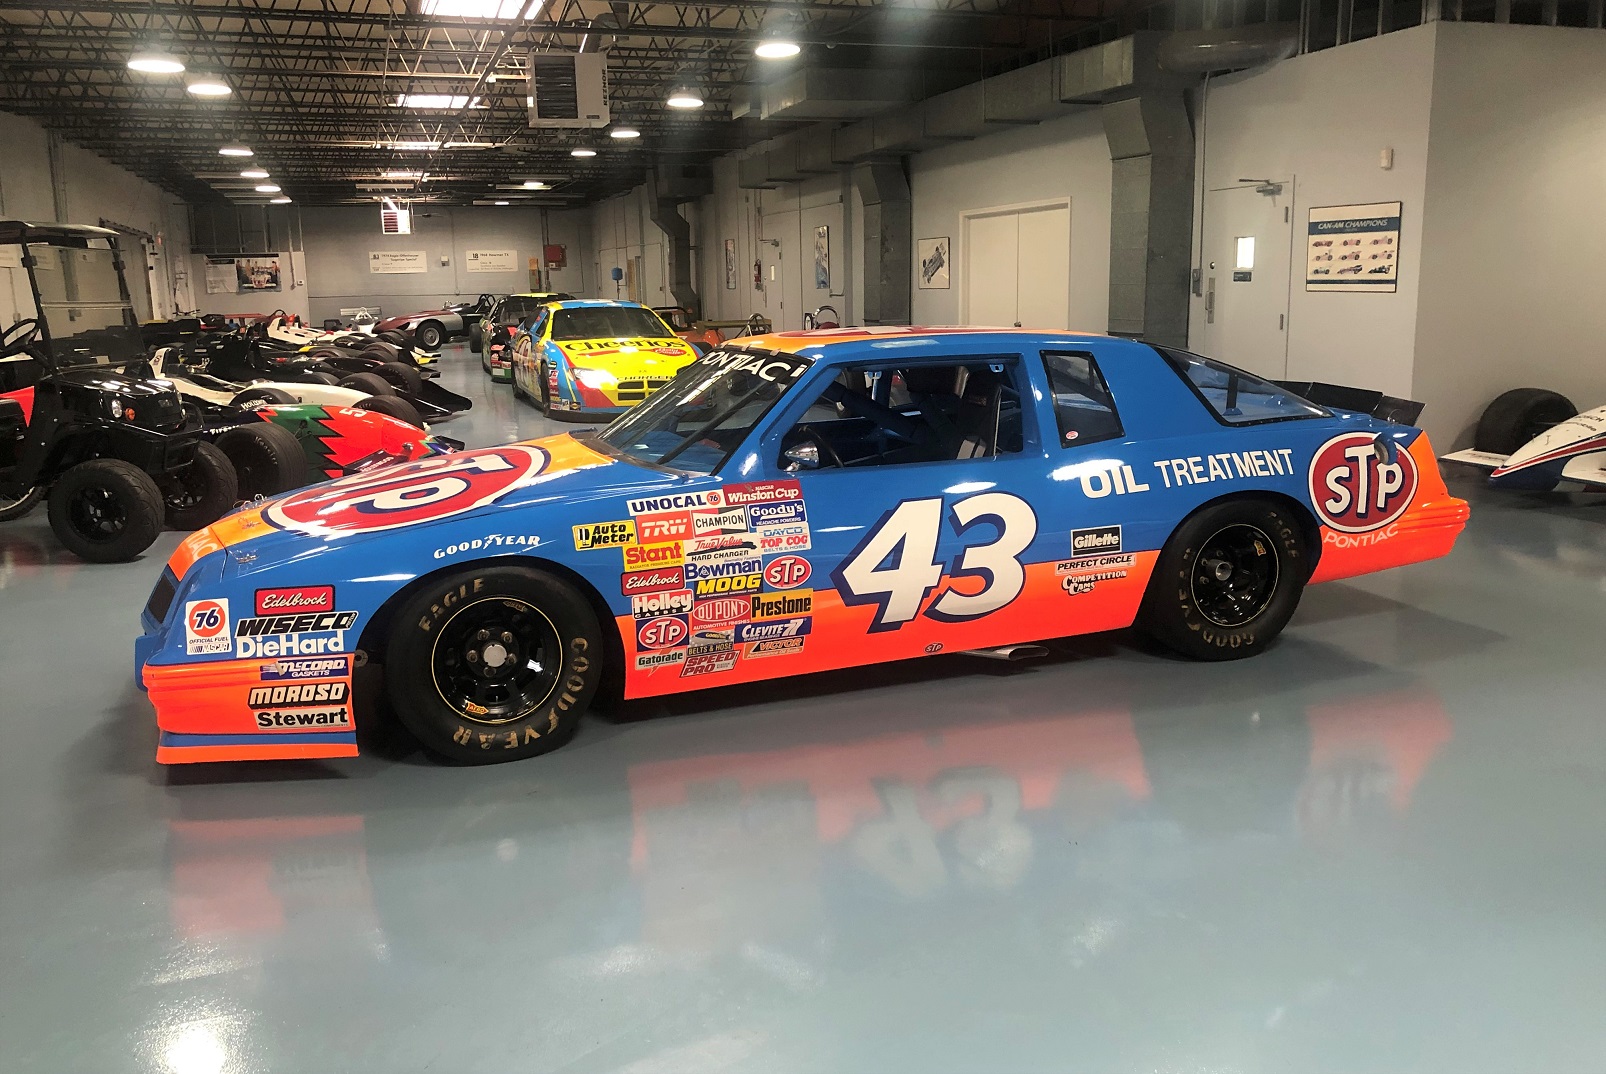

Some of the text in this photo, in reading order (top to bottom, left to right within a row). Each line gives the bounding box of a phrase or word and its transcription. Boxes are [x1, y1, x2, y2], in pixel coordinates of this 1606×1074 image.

[1318, 219, 1388, 229] CAN-AM CHAMPIONS
[564, 340, 686, 351] Cheerios
[1080, 448, 1294, 499] OIL TREATMENT
[1325, 444, 1403, 514] STP
[631, 494, 718, 513] UNOCAL 76
[728, 488, 799, 502] Winston Cup
[751, 503, 803, 518] Goody's
[641, 518, 687, 538] TRW
[695, 514, 744, 528] CHAMPION
[592, 524, 626, 536] Auto
[763, 526, 803, 537] DAYCO
[1324, 524, 1399, 548] PONTIAC
[590, 533, 633, 547] Meter
[694, 536, 743, 551] True Value
[761, 535, 808, 548] TOP COG
[1074, 533, 1119, 548] Gillette
[626, 542, 681, 565] Stant
[692, 550, 748, 562] HARD CHARGER
[835, 491, 1038, 628] 43
[1057, 558, 1099, 570] PERFECT
[1100, 554, 1132, 565] CIRCLE
[684, 560, 762, 579] Bowman
[770, 559, 805, 583] STP
[626, 572, 680, 589] Edelbrock
[697, 574, 762, 594] MOOG
[1062, 570, 1128, 590] COMPETITION
[262, 592, 327, 609] Edelbrock
[633, 593, 692, 613] Holley
[752, 596, 811, 618] Prestone
[194, 607, 220, 630] 76
[698, 600, 745, 620] DU PONT
[236, 612, 354, 637] WISECO
[645, 620, 681, 643] STP
[693, 621, 727, 630] AUTOMOTIVE
[742, 619, 804, 638] CLEVITE 77
[236, 630, 344, 658] DieHard
[689, 645, 707, 655] BELTS
[715, 642, 732, 651] HOSE
[760, 638, 803, 651] VICTOR
[925, 643, 943, 653] STP
[638, 652, 683, 665] Gatorade
[686, 652, 735, 667] SPEED
[682, 663, 715, 676] PRO
[250, 683, 346, 705] MOROSO
[257, 708, 348, 727] Stewart
